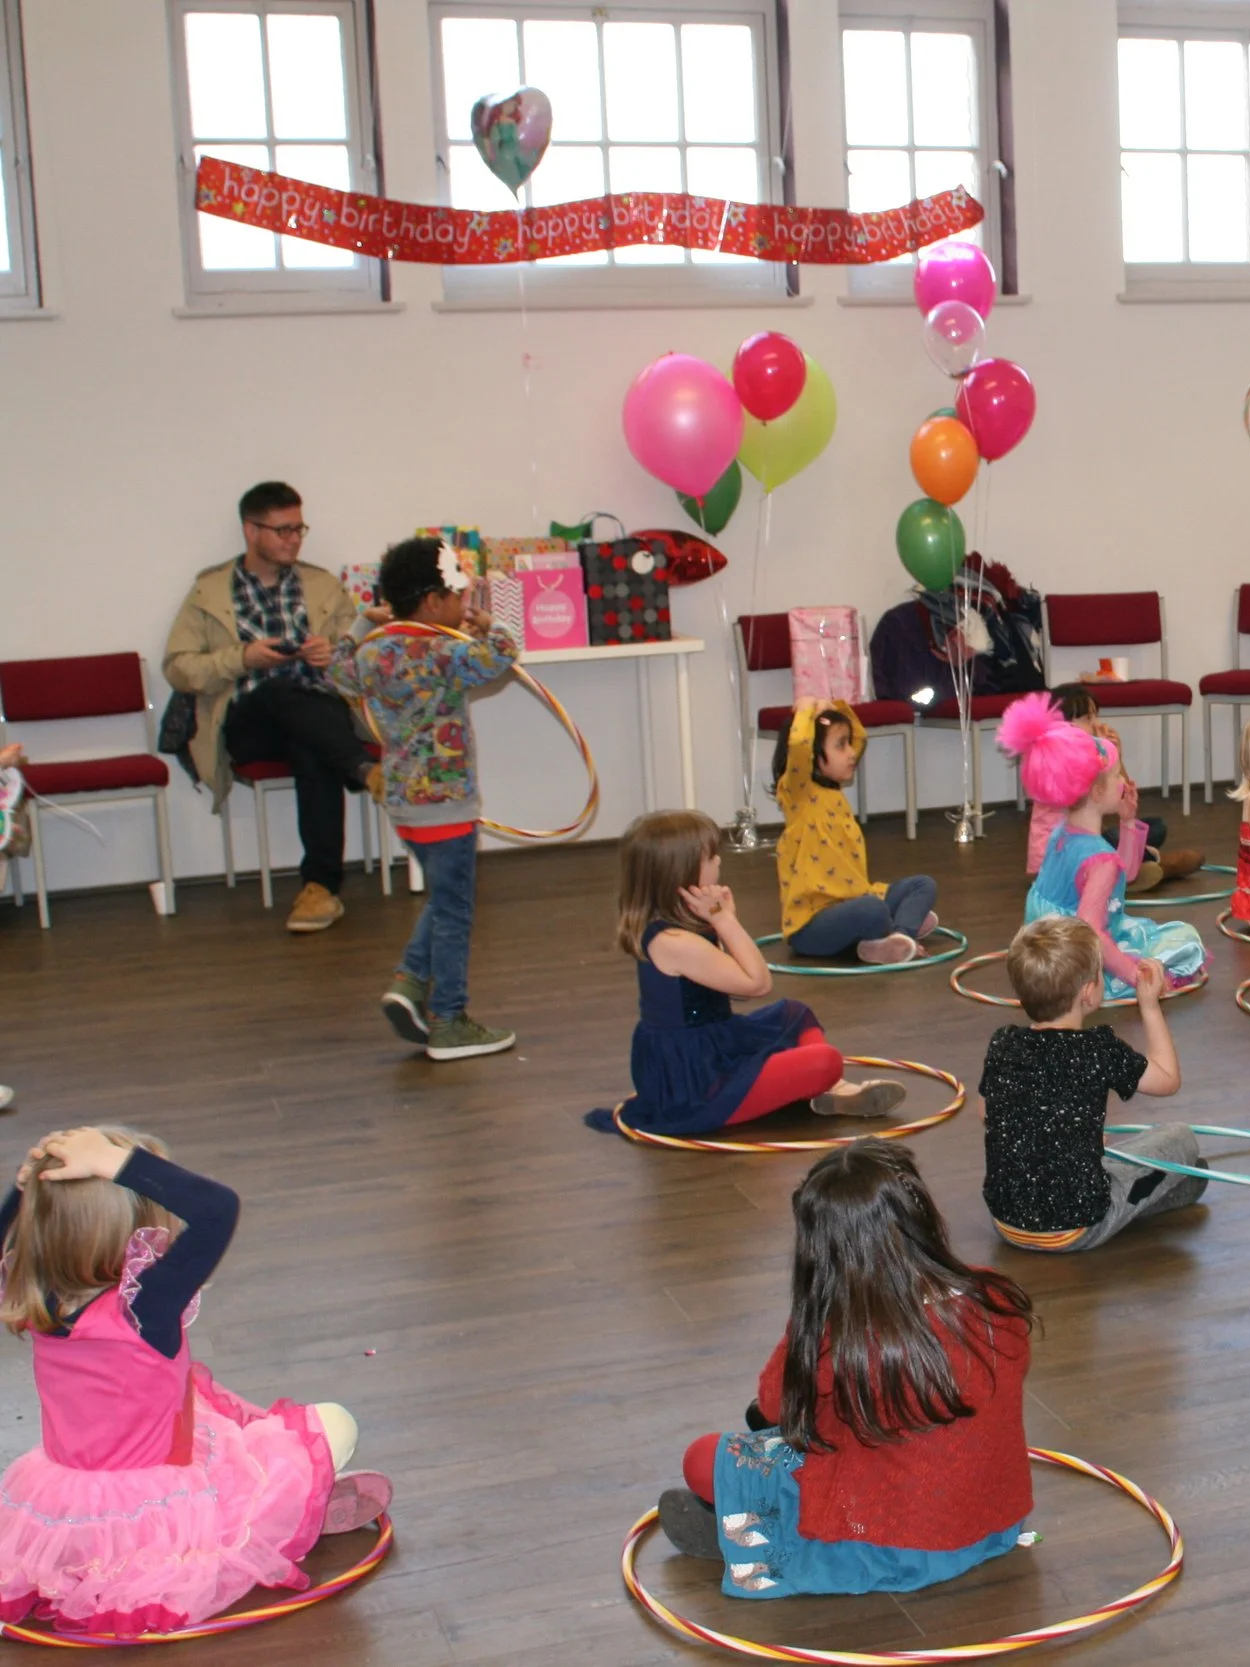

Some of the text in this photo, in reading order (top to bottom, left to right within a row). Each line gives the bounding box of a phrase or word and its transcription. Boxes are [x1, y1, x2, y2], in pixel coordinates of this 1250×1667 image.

[223, 168, 323, 227] happy
[340, 193, 473, 252] birthday
[517, 209, 598, 246] happy
[773, 211, 858, 253] happy
[860, 204, 963, 242] brthday
